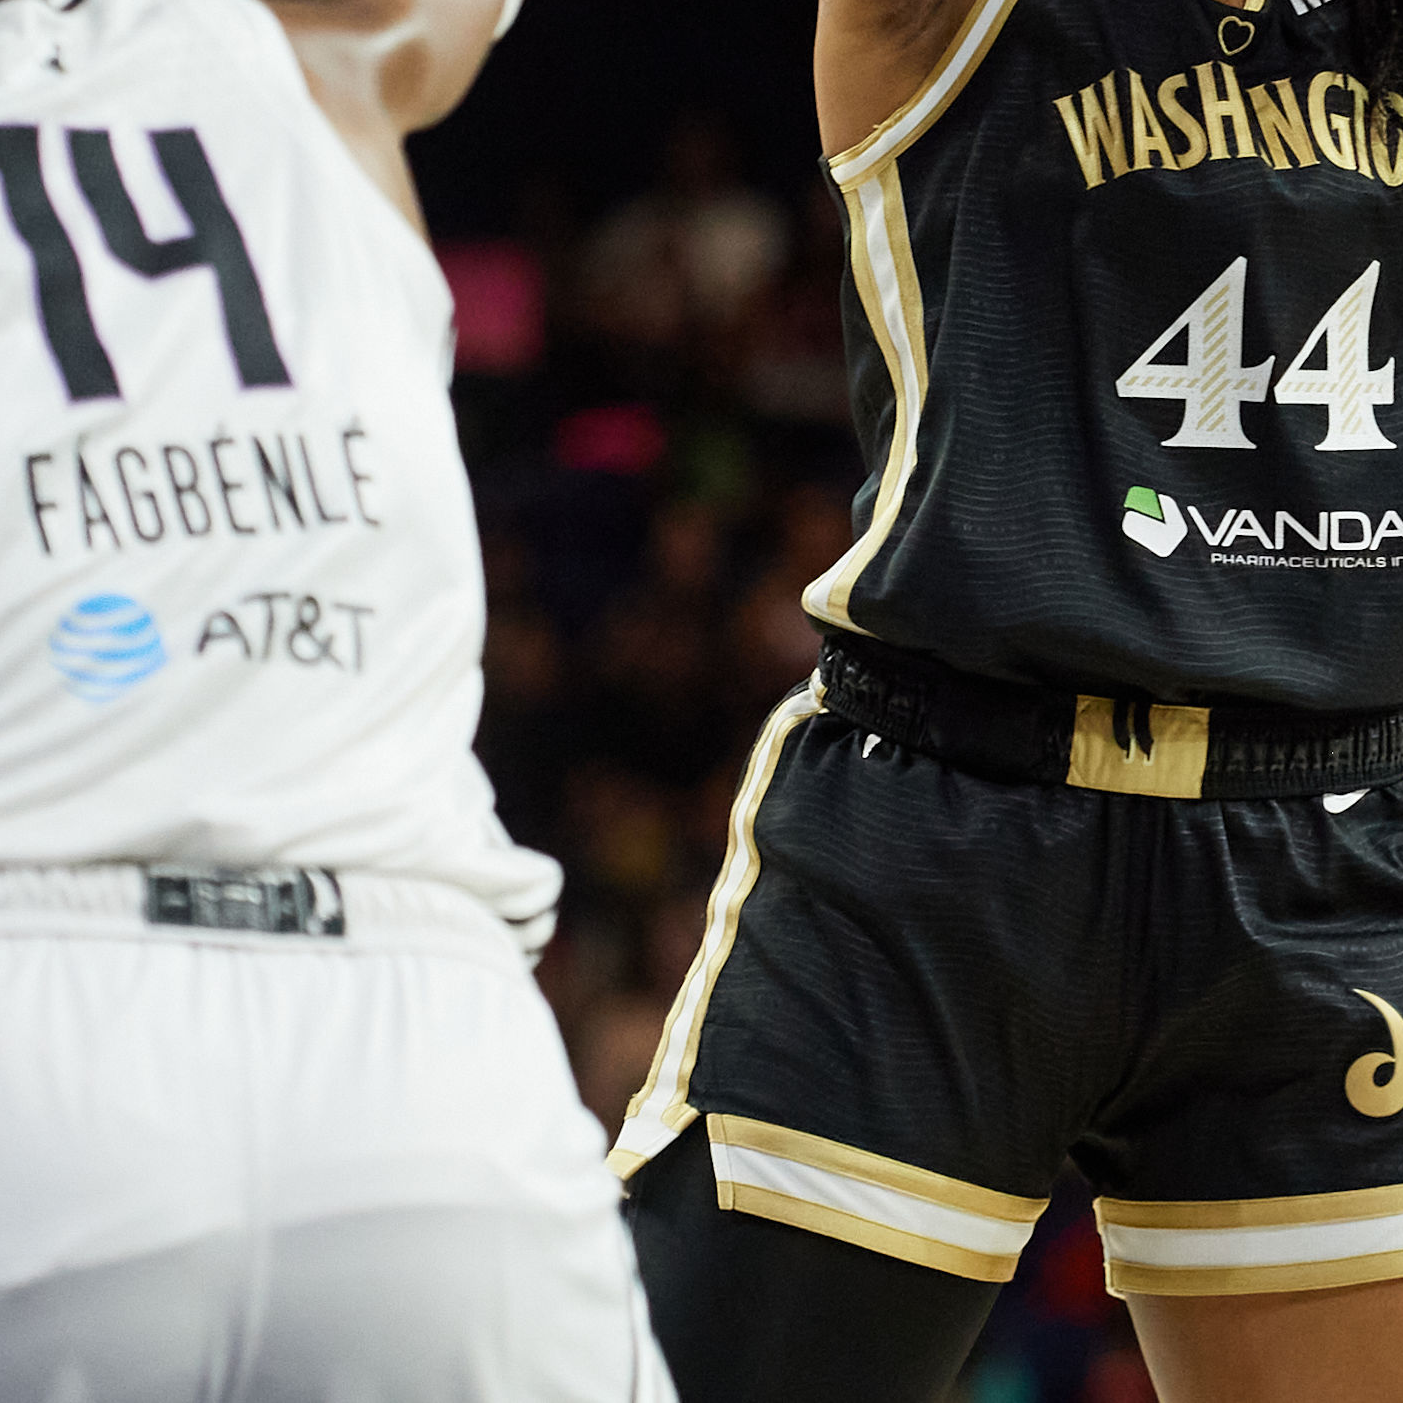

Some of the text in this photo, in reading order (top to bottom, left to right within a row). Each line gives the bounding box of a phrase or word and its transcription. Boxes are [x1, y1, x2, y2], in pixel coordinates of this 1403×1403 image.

[1115, 255, 1397, 451] 44
[1210, 552, 1387, 569] PHARMACEUTICALS
[195, 591, 375, 675] AT&T
